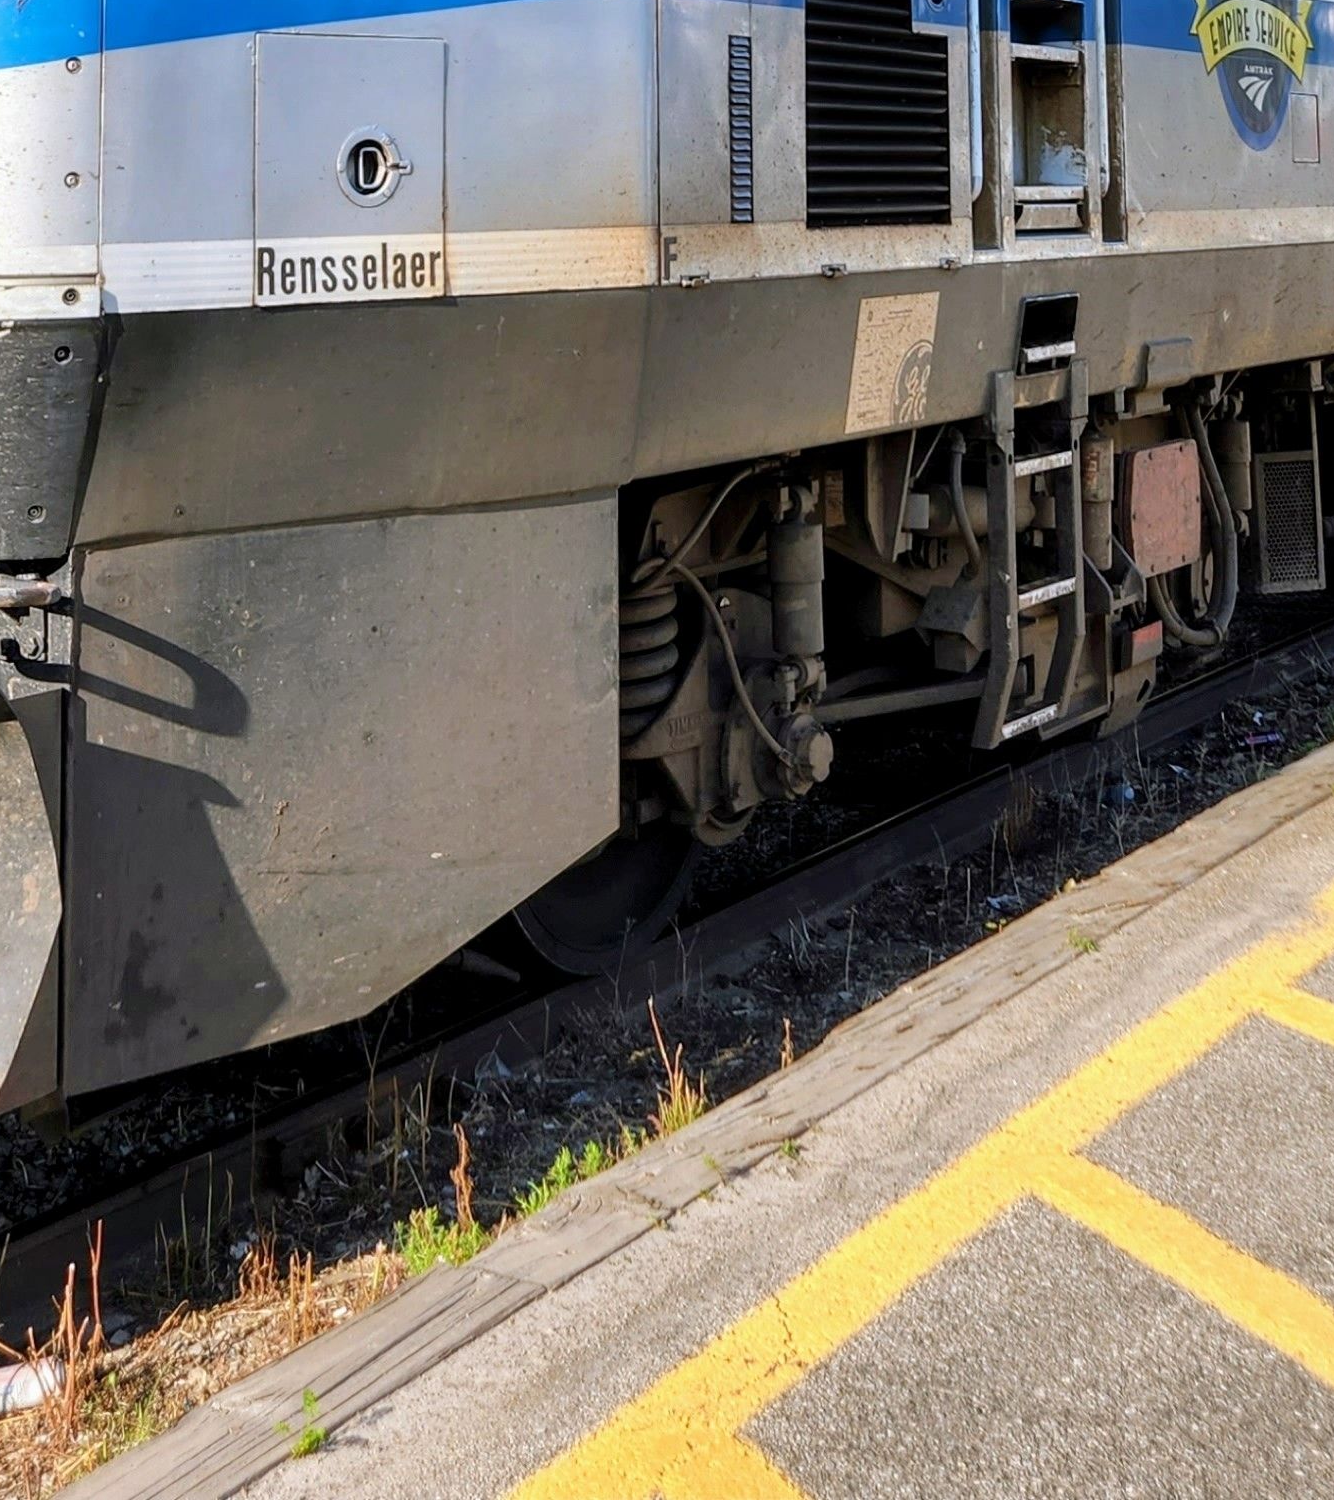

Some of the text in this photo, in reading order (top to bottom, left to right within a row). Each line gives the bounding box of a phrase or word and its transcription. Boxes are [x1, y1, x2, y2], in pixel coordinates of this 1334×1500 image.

[1209, 8, 1296, 63] EMPIRE SERVICE
[1244, 64, 1274, 76] AMTRAK
[257, 243, 441, 296] Rensselaer
[663, 236, 677, 281] F
